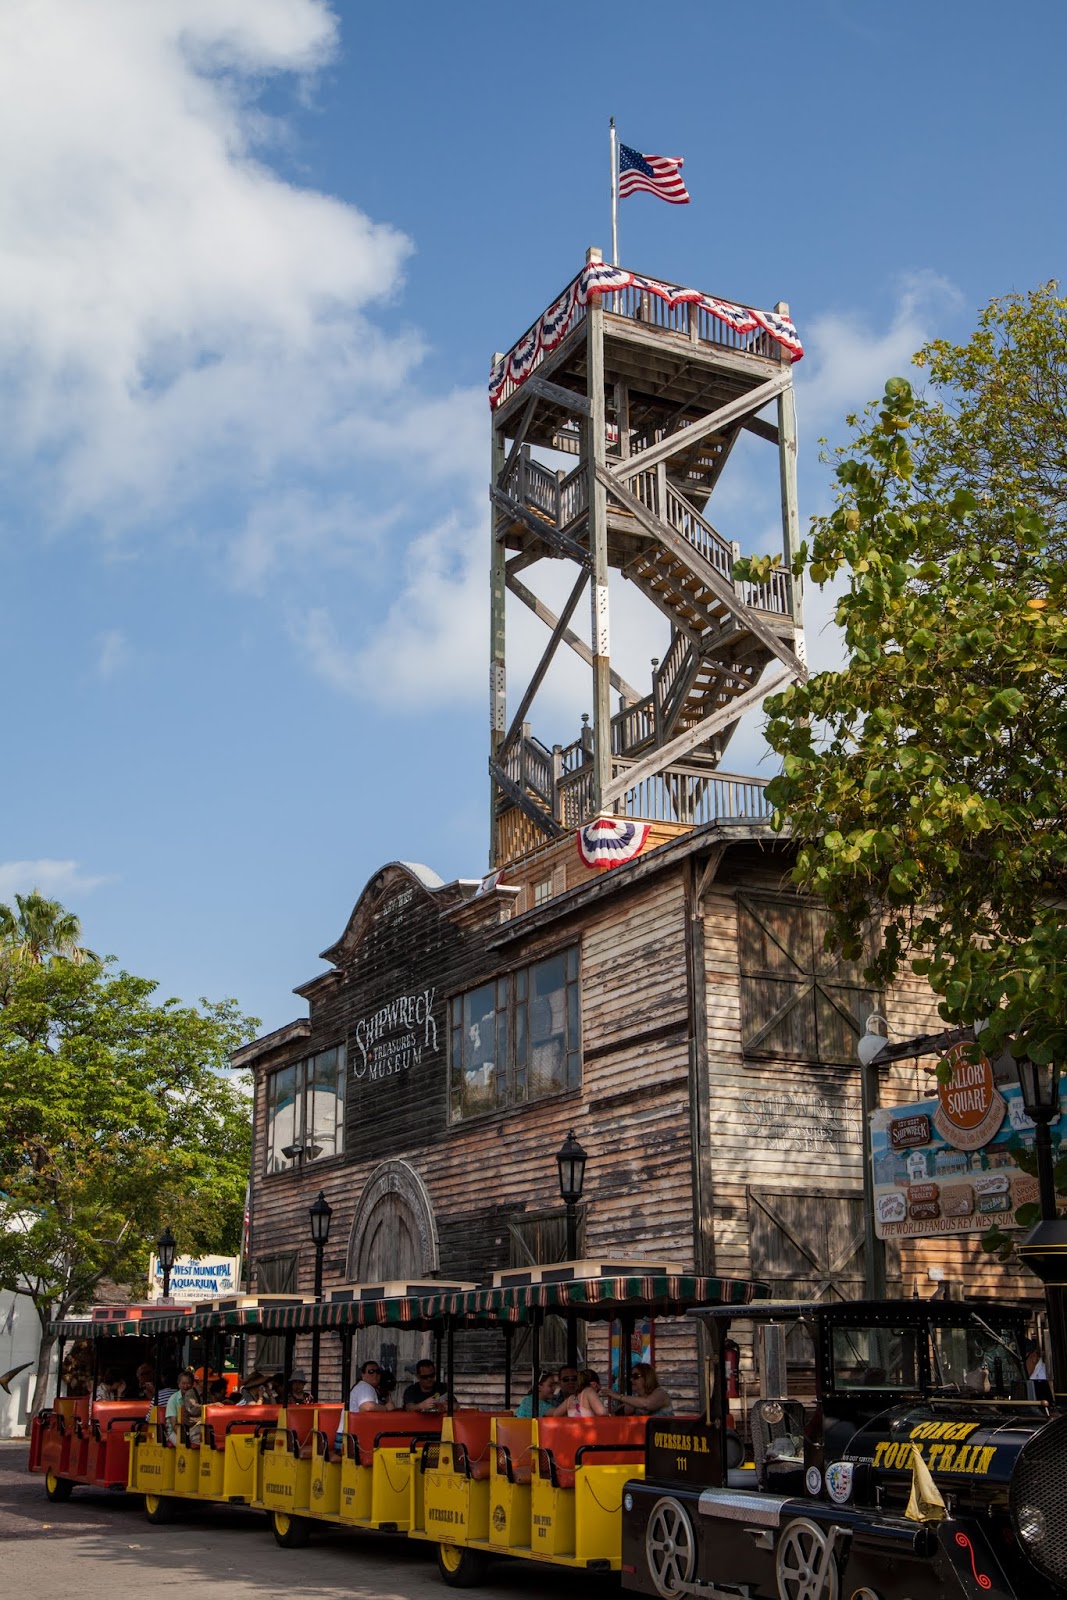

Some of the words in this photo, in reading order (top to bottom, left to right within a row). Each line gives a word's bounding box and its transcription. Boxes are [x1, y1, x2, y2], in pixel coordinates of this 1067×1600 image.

[354, 987, 440, 1078] SHIPWRECK
[373, 1032, 417, 1061] TREASURES
[369, 1045, 423, 1082] MUSEUM
[948, 1087, 988, 1119] SQUARE
[743, 1091, 864, 1152] SHIPWRECK
[893, 1123, 928, 1143] SHIPWRECK
[766, 1137, 840, 1153] MUSEUM
[909, 1186, 920, 1194] OLD
[919, 1185, 934, 1193] TOWN
[911, 1191, 933, 1199] TROLLEY
[881, 1223, 896, 1236] THE
[896, 1222, 924, 1235] WORLD
[924, 1218, 955, 1232] FAMOUS
[958, 1216, 975, 1229] KEY
[975, 1214, 998, 1228] WEST
[174, 1265, 192, 1275] WEST
[193, 1263, 231, 1276] MUNICIPAL
[168, 1279, 218, 1292] AQUARIUM
[909, 1421, 980, 1441] CONCH
[654, 1432, 692, 1451] OVERSEAS
[693, 1436, 710, 1453] R.R.
[676, 1457, 687, 1471] 111
[871, 1441, 924, 1470] TOUR
[928, 1443, 998, 1474] TRAIN
[429, 1508, 453, 1523] OVERSEAS
[538, 1528, 547, 1538] KEY
